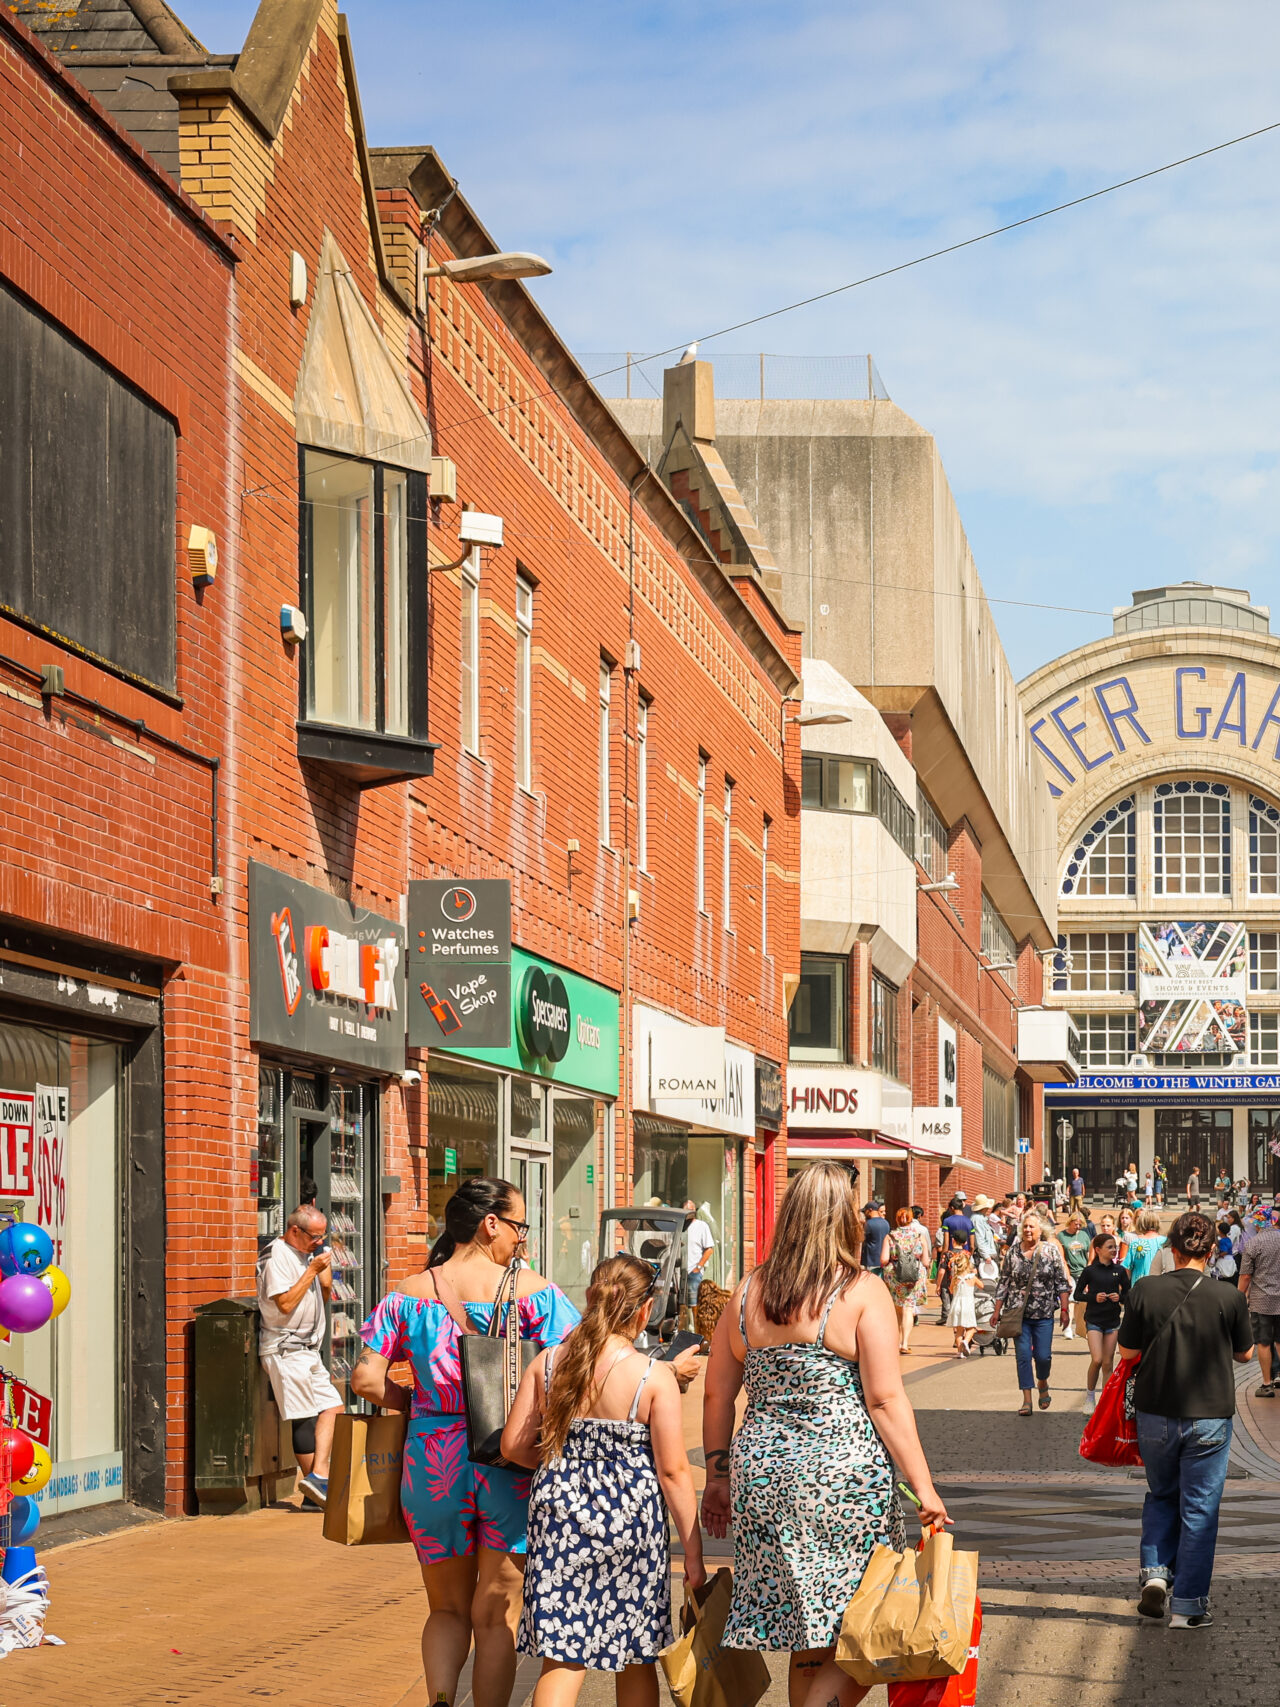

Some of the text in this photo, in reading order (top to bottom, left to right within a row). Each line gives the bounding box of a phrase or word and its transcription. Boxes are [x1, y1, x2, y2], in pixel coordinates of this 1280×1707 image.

[432, 928, 494, 940] Watches
[432, 943, 499, 955] Perfumes
[448, 974, 487, 1000] Vape
[460, 989, 497, 1015] Shop
[532, 990, 568, 1032] Specsavers
[577, 1013, 600, 1049] Opticians
[658, 1078, 717, 1090] ROMAN
[1066, 1077, 1134, 1088] WELCOME
[1138, 1077, 1158, 1088] TO
[1161, 1077, 1190, 1088] THE
[1195, 1076, 1253, 1088] WINTER
[3, 1103, 28, 1122] DOWN
[921, 1122, 951, 1135] M&S
[49, 1474, 78, 1500] HANDBAGS
[83, 1469, 99, 1491] CARDS
[105, 1466, 122, 1487] GAMES
